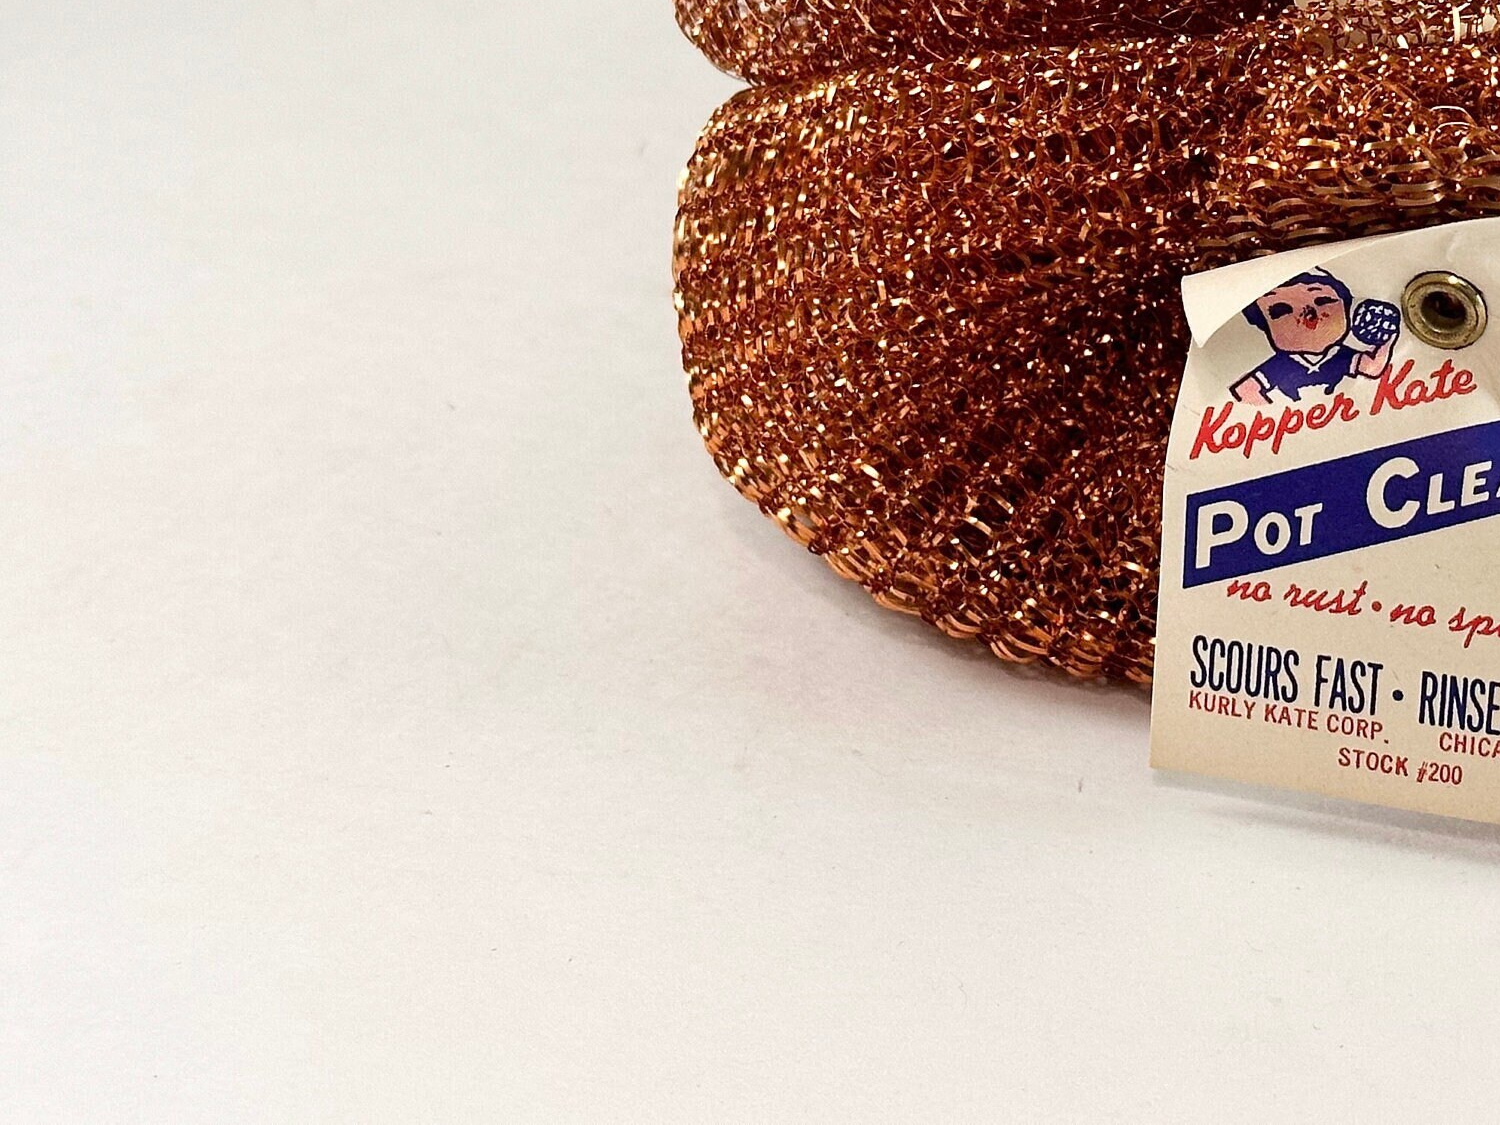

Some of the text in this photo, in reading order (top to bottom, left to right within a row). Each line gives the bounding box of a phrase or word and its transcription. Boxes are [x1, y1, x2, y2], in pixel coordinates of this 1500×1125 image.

[1189, 358, 1477, 460] Kopper Kate
[1195, 500, 1323, 569] POT
[1226, 579, 1272, 603] no
[1282, 580, 1369, 616] rust
[1390, 601, 1437, 626] no
[1189, 635, 1299, 703] SCOURS
[1313, 655, 1384, 715] FAST
[1188, 689, 1257, 721] KURLY
[1263, 699, 1319, 730] KATE
[1326, 712, 1390, 745] CORP.
[1338, 747, 1463, 786] STOCK #200
